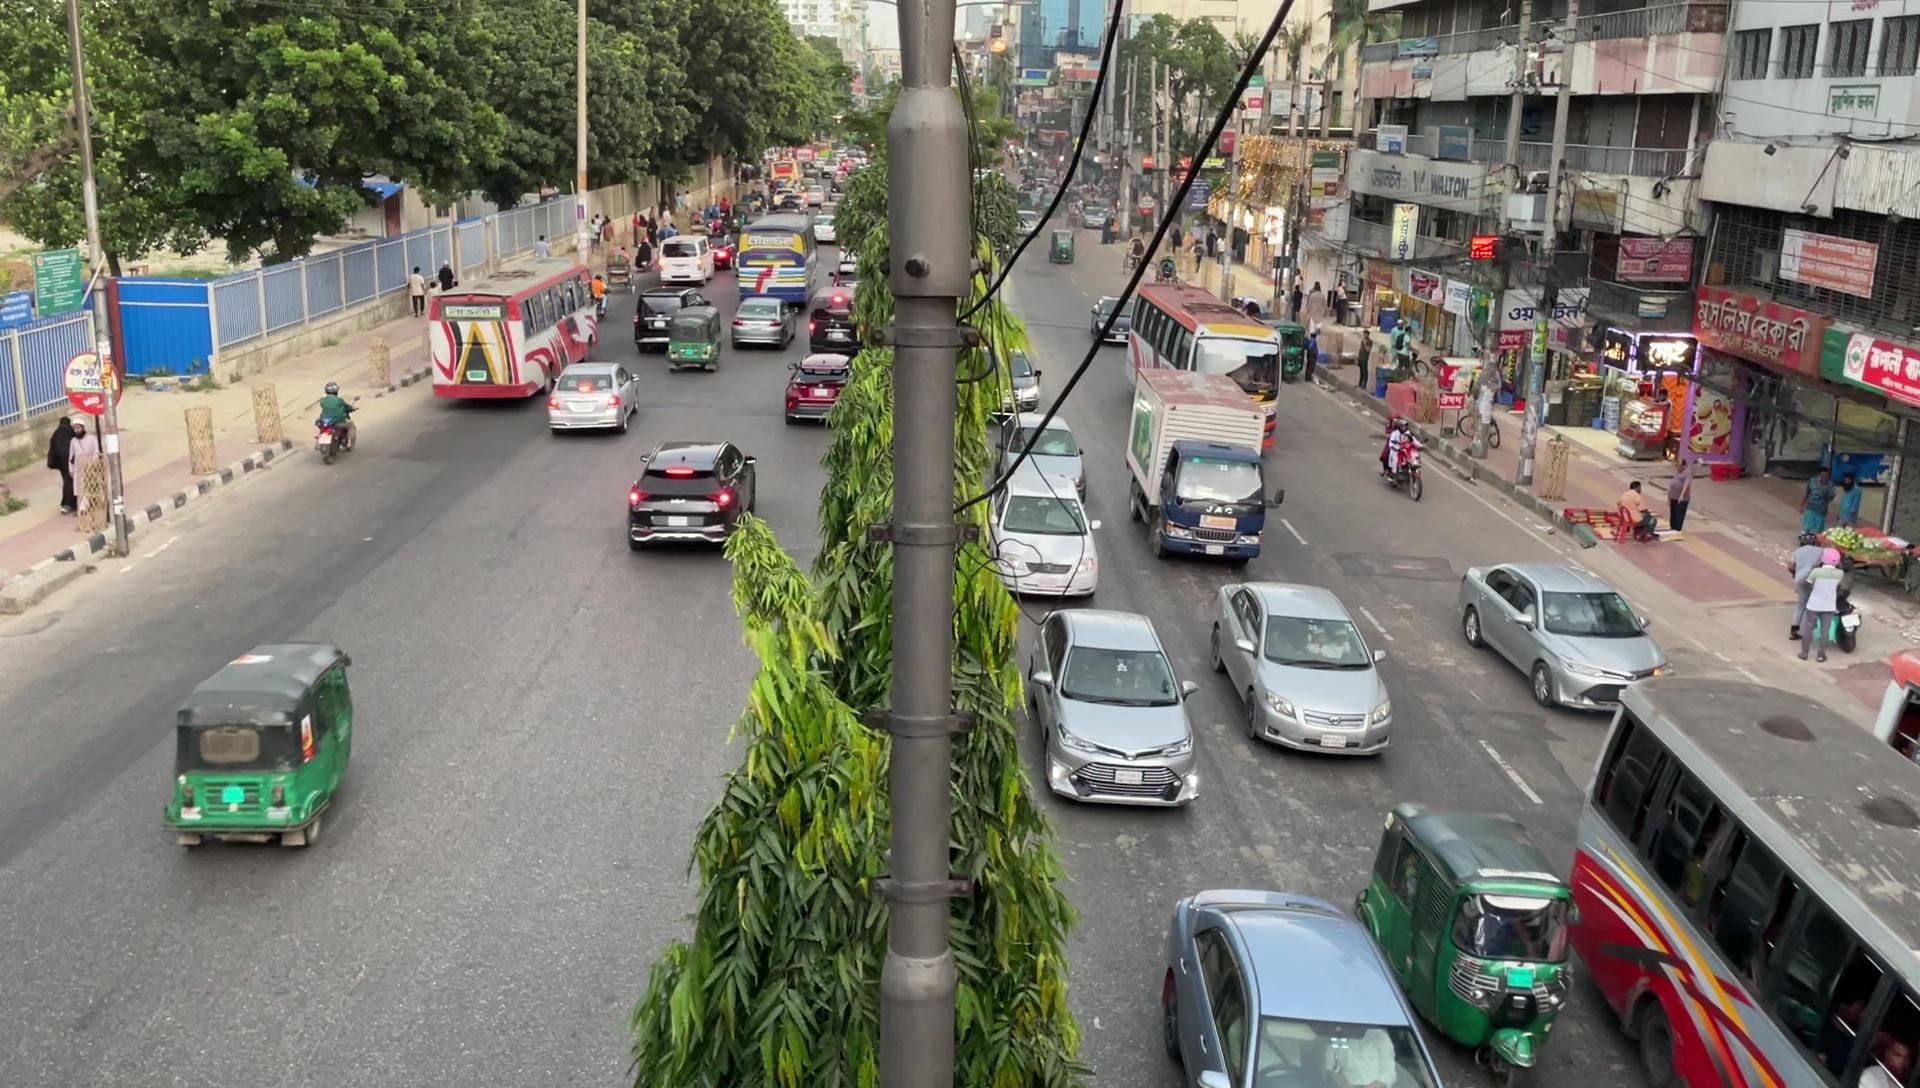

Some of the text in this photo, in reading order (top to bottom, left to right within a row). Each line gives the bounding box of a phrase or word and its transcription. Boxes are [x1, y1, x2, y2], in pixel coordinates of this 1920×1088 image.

[1431, 174, 1470, 199] WALTON
[1698, 299, 1809, 353] মুসলিম বেকারী
[1205, 506, 1233, 515] JAC
